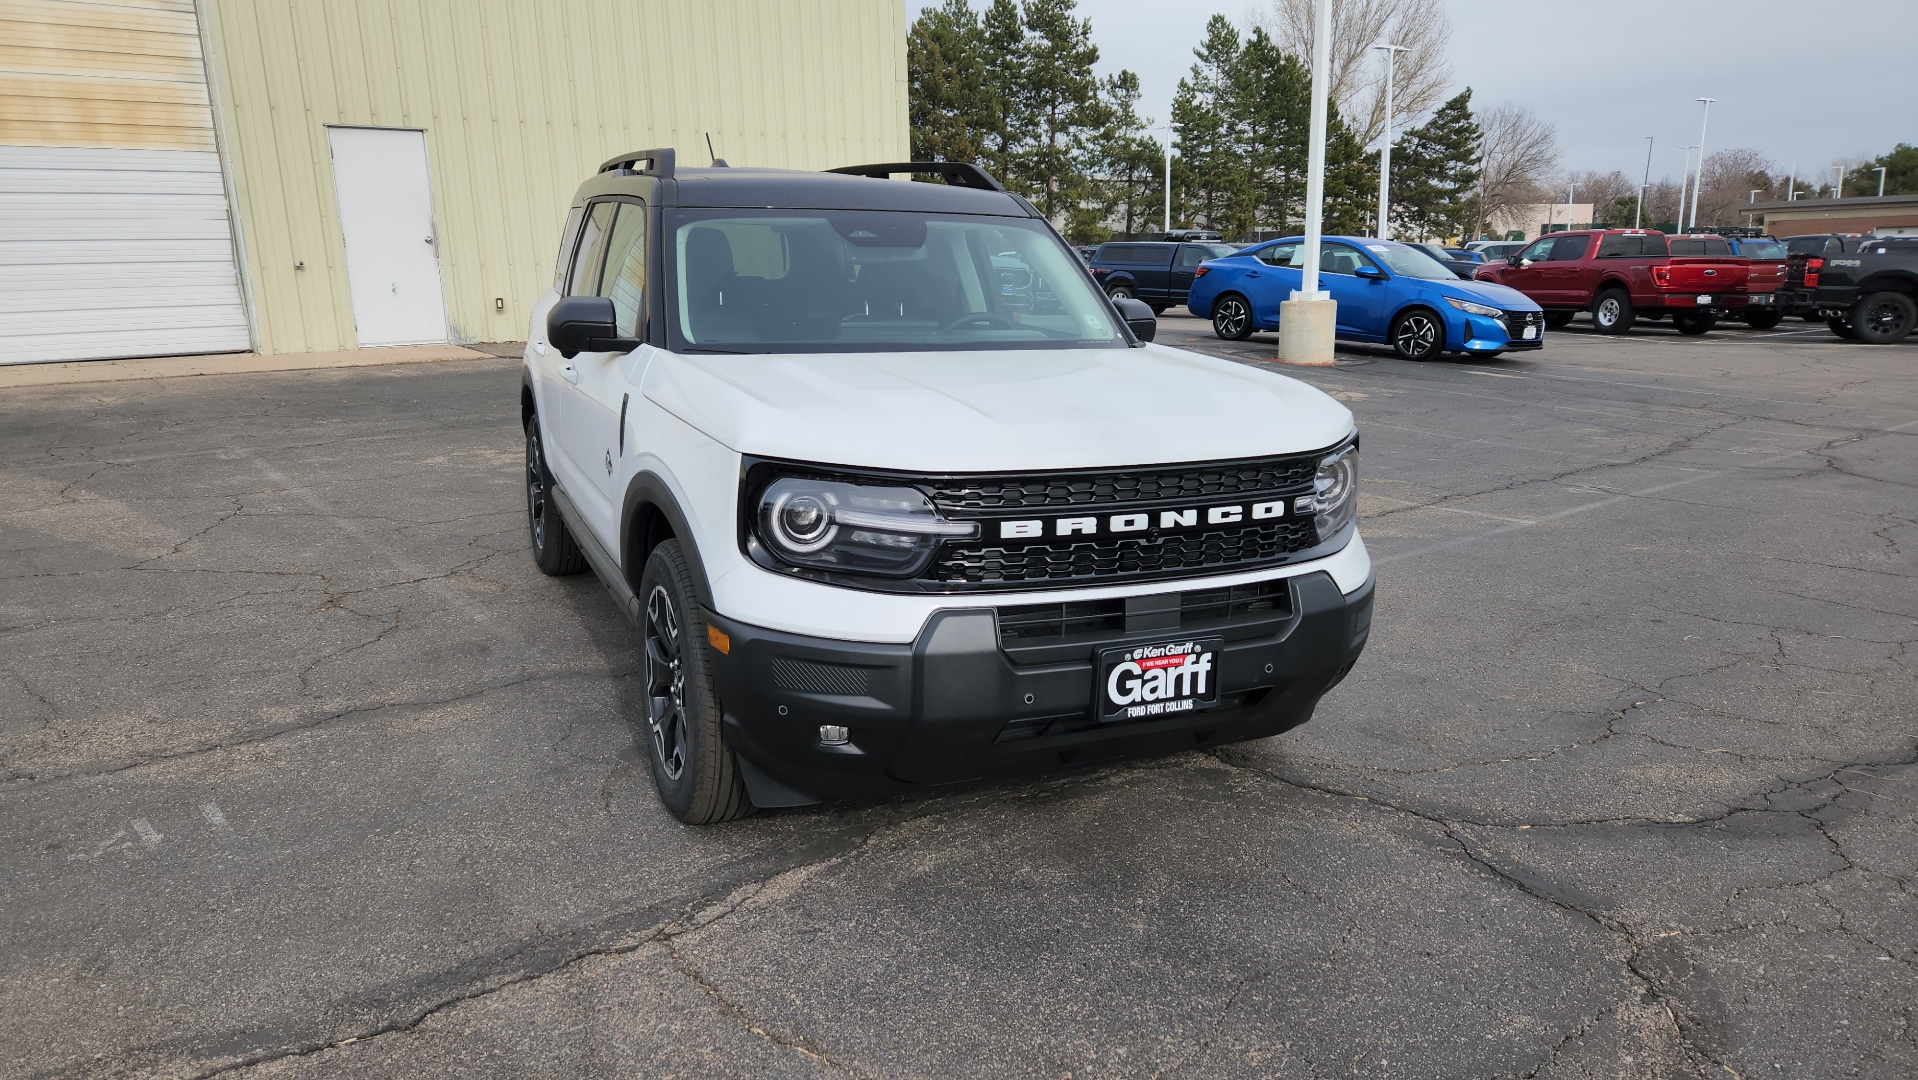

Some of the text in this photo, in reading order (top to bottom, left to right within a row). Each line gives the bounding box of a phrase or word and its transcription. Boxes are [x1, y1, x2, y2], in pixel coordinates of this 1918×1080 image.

[1000, 501, 1285, 538] BRONCO
[1143, 646, 1165, 658] Ken
[1166, 642, 1194, 656] Garff
[1107, 652, 1212, 705] Garff
[1127, 699, 1194, 717] FORD FORT COLLINS
